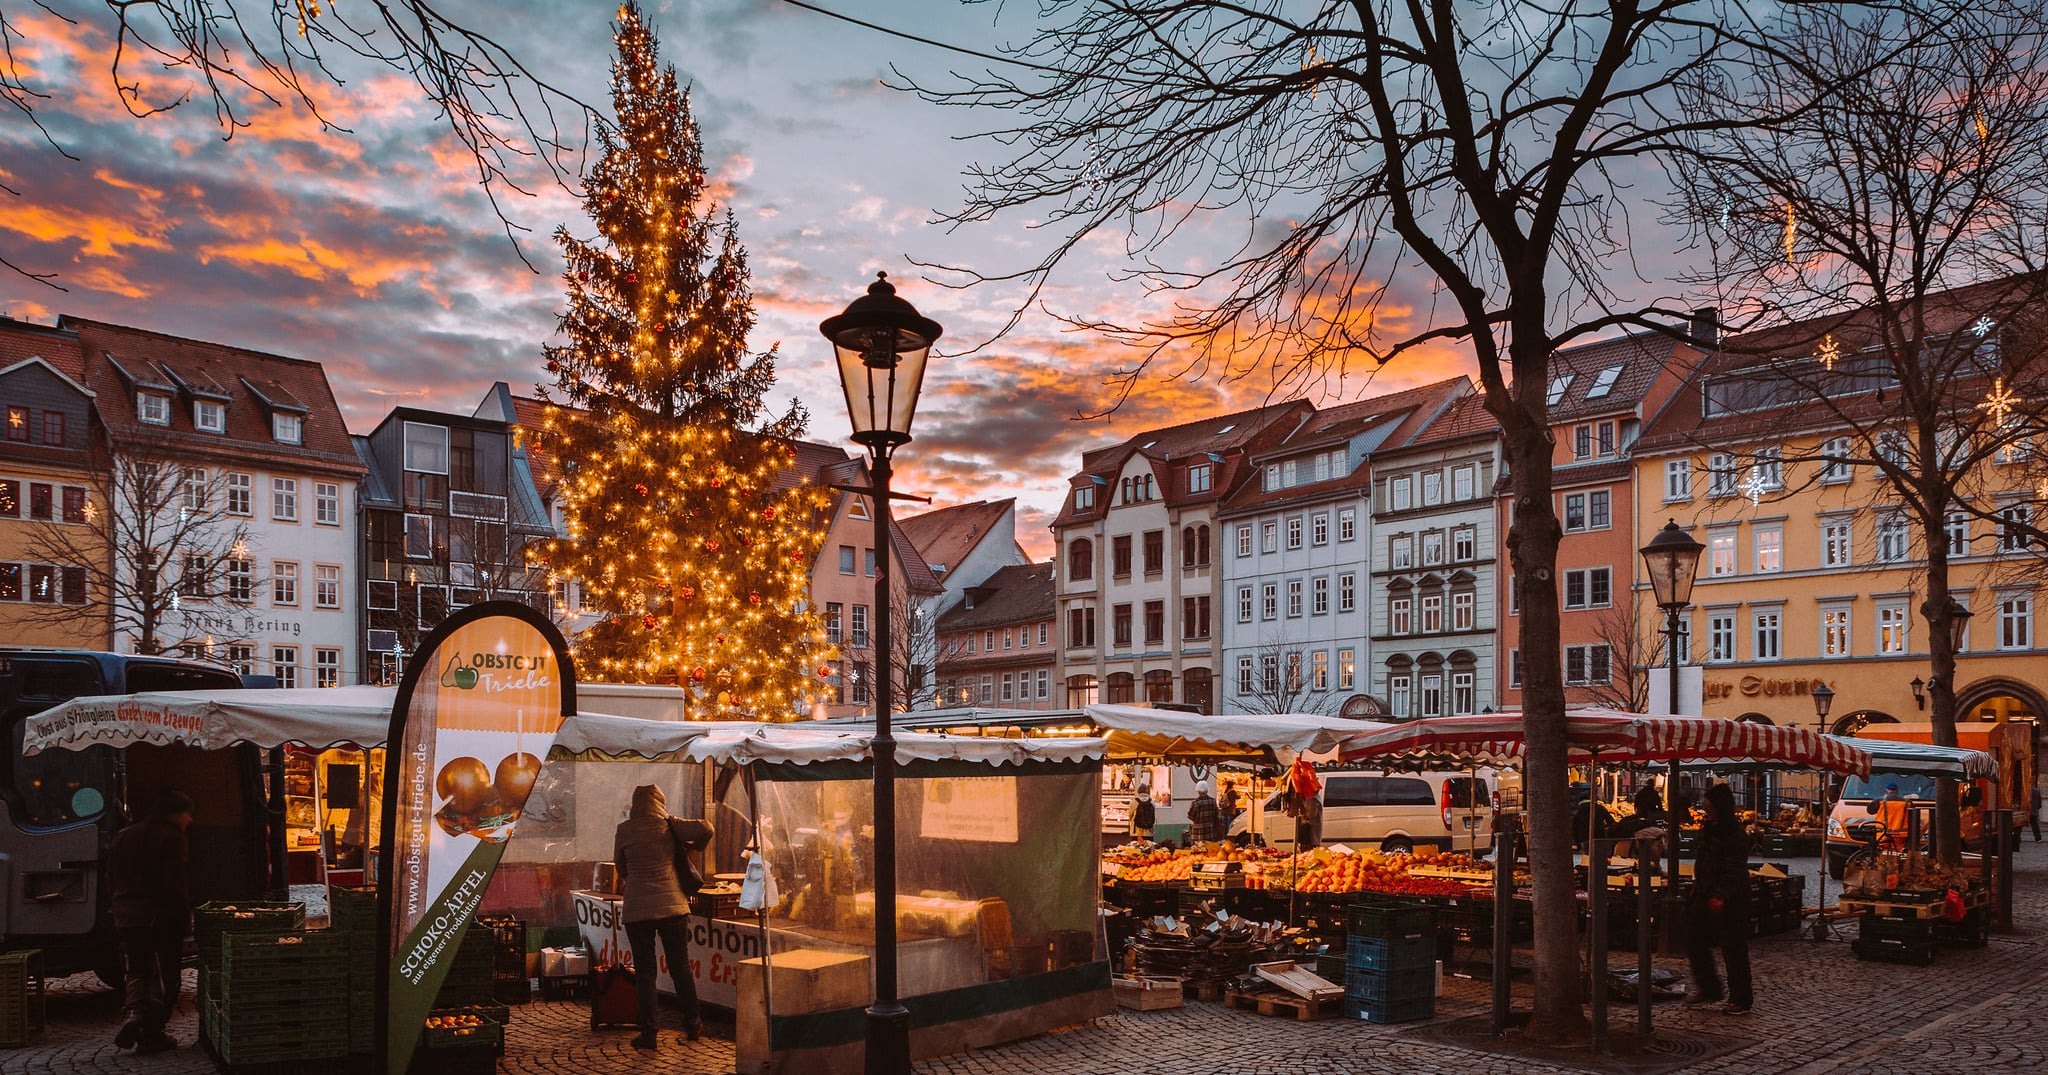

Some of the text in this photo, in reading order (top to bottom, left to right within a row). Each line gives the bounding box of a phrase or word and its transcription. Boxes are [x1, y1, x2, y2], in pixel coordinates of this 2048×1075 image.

[244, 616, 301, 637] Hering
[472, 653, 546, 671] OBSTGUT
[479, 669, 551, 694] Triebe
[1703, 681, 1733, 699] ur
[54, 718, 68, 732] aus
[407, 743, 427, 916] www.obstgut-triebe.de
[400, 868, 487, 979] SCHOKO-ÄPFEL
[574, 899, 623, 931] Obst
[411, 894, 482, 985] aus eigener Produktion
